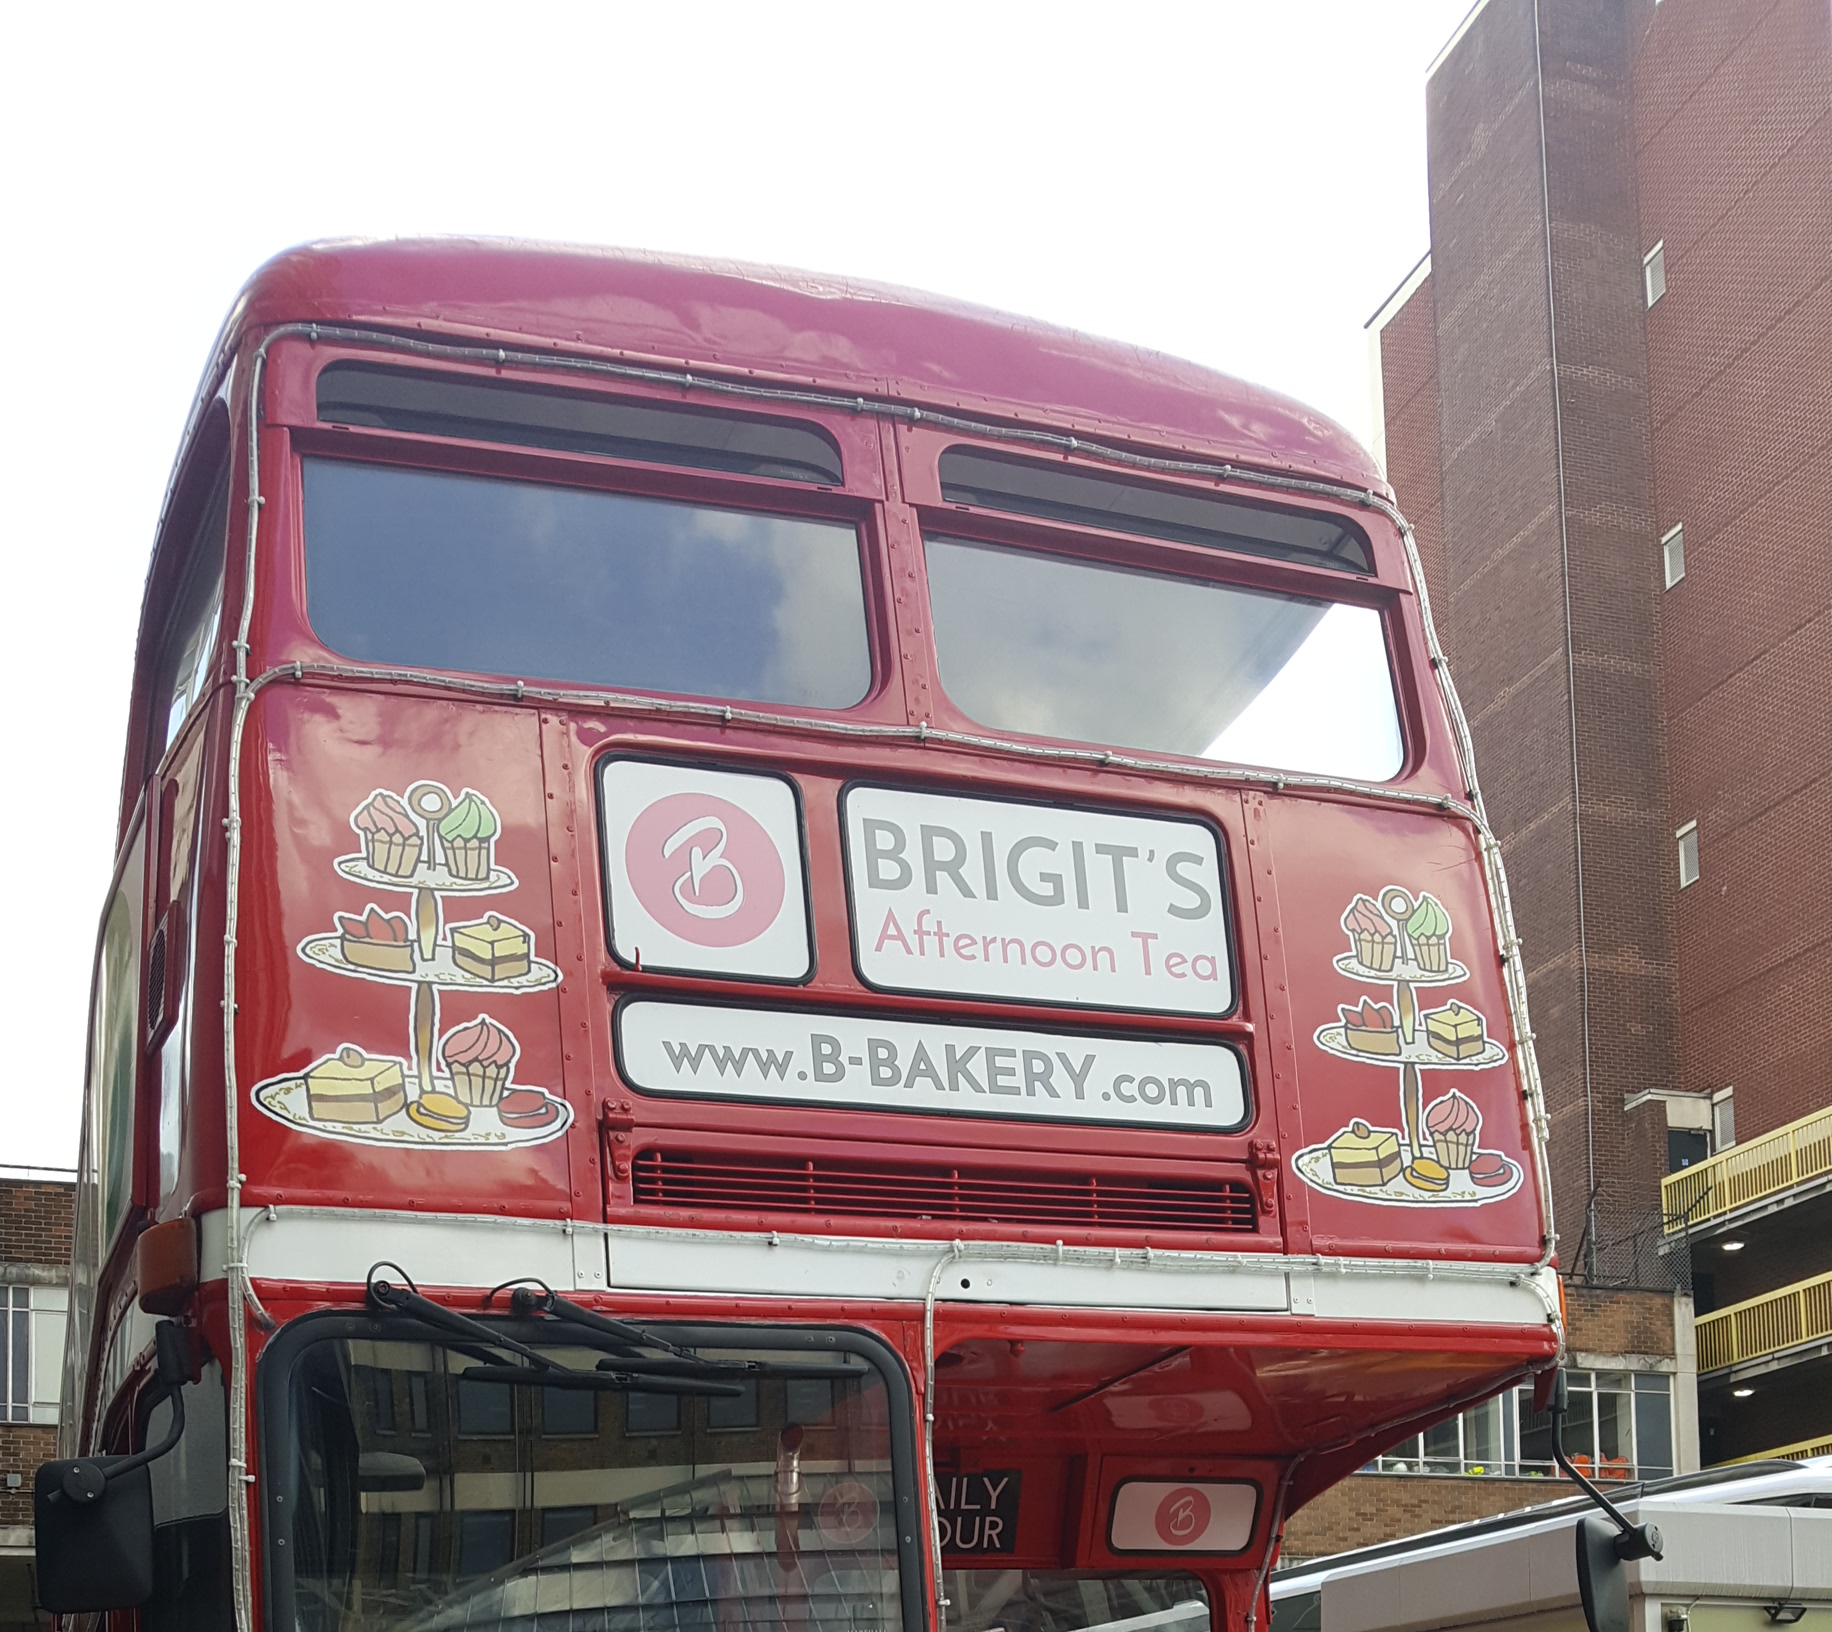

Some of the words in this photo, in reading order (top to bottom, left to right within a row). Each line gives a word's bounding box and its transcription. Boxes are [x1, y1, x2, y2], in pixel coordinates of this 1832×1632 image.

[661, 815, 744, 920] B
[862, 817, 1212, 920] BRIGIT'S
[873, 905, 1117, 974] Afternoon
[1129, 930, 1219, 982] Tea
[661, 1032, 1214, 1109] www.B-BAKERY.com
